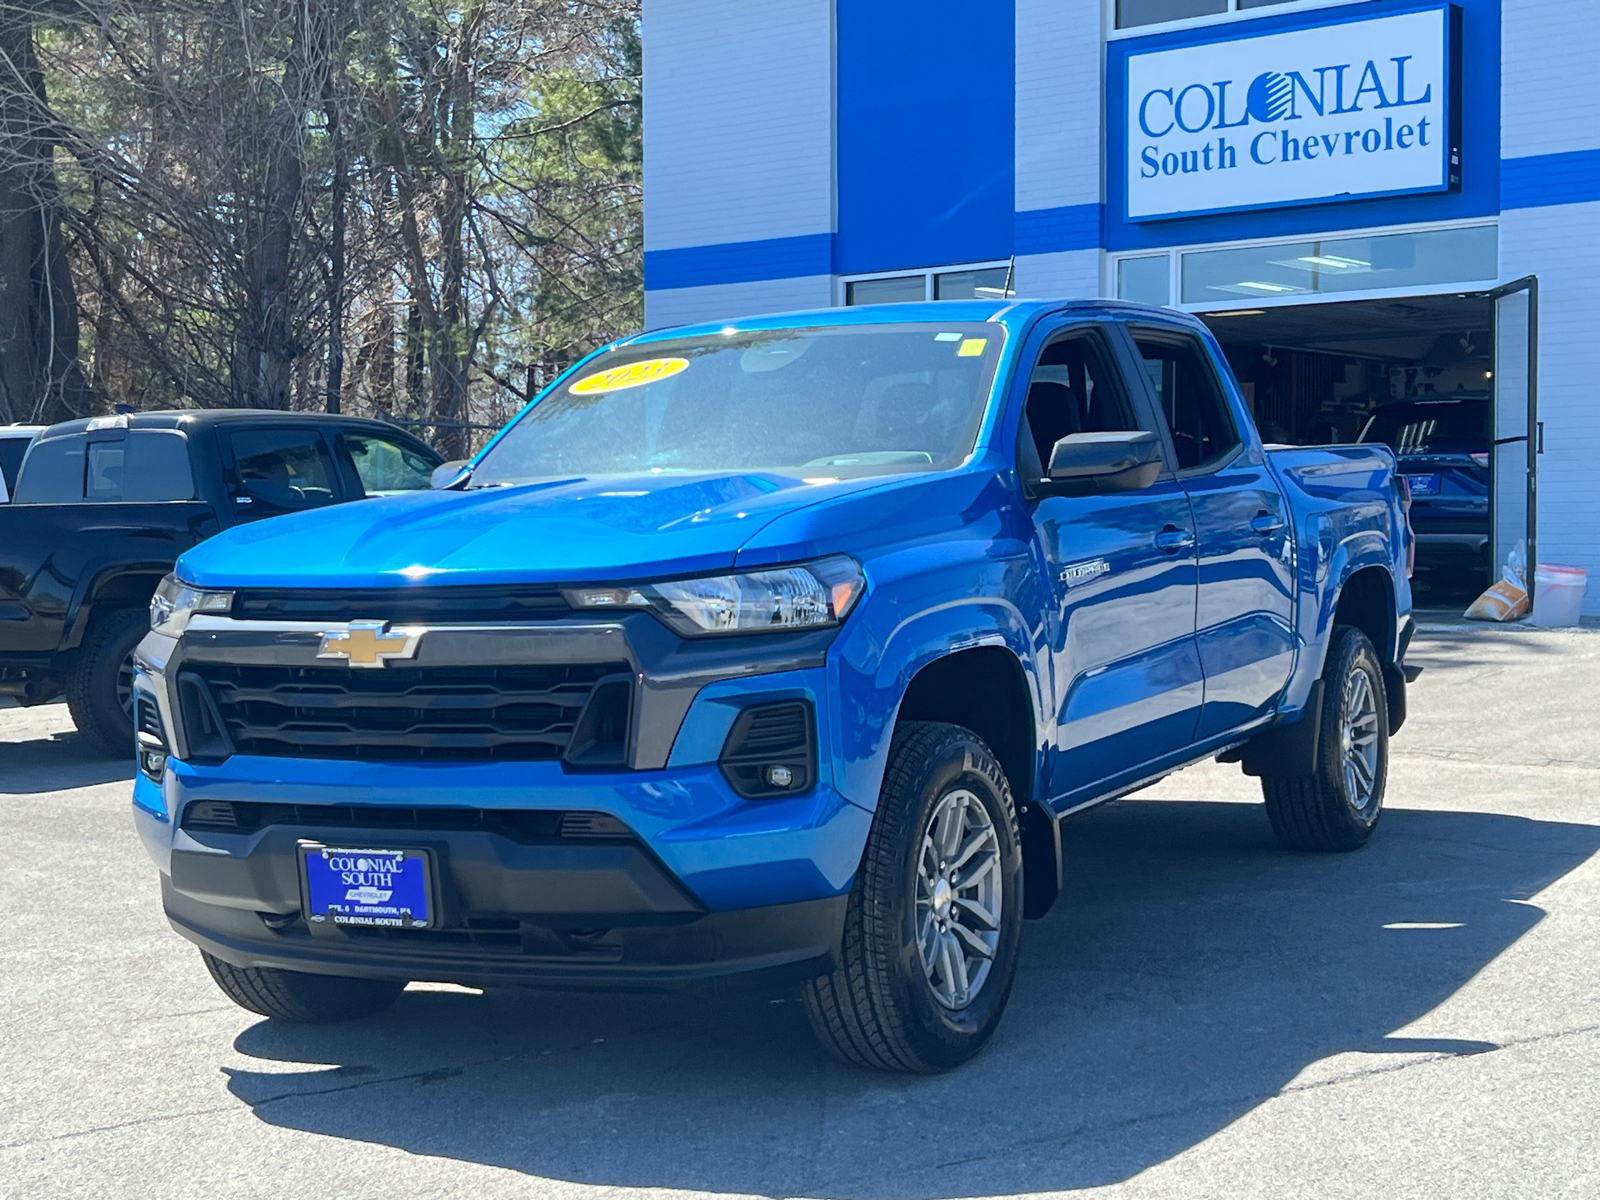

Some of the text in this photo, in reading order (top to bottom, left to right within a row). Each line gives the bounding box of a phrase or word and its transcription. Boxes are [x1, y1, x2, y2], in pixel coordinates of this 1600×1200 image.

[1138, 55, 1432, 138] COLONIAL
[1140, 115, 1432, 179] South Chevrolet
[329, 857, 403, 873] COLONIAL
[341, 872, 392, 887] SOUTH
[349, 890, 388, 899] CHEVROLET
[333, 916, 403, 927] COLONIAL SOUTH
